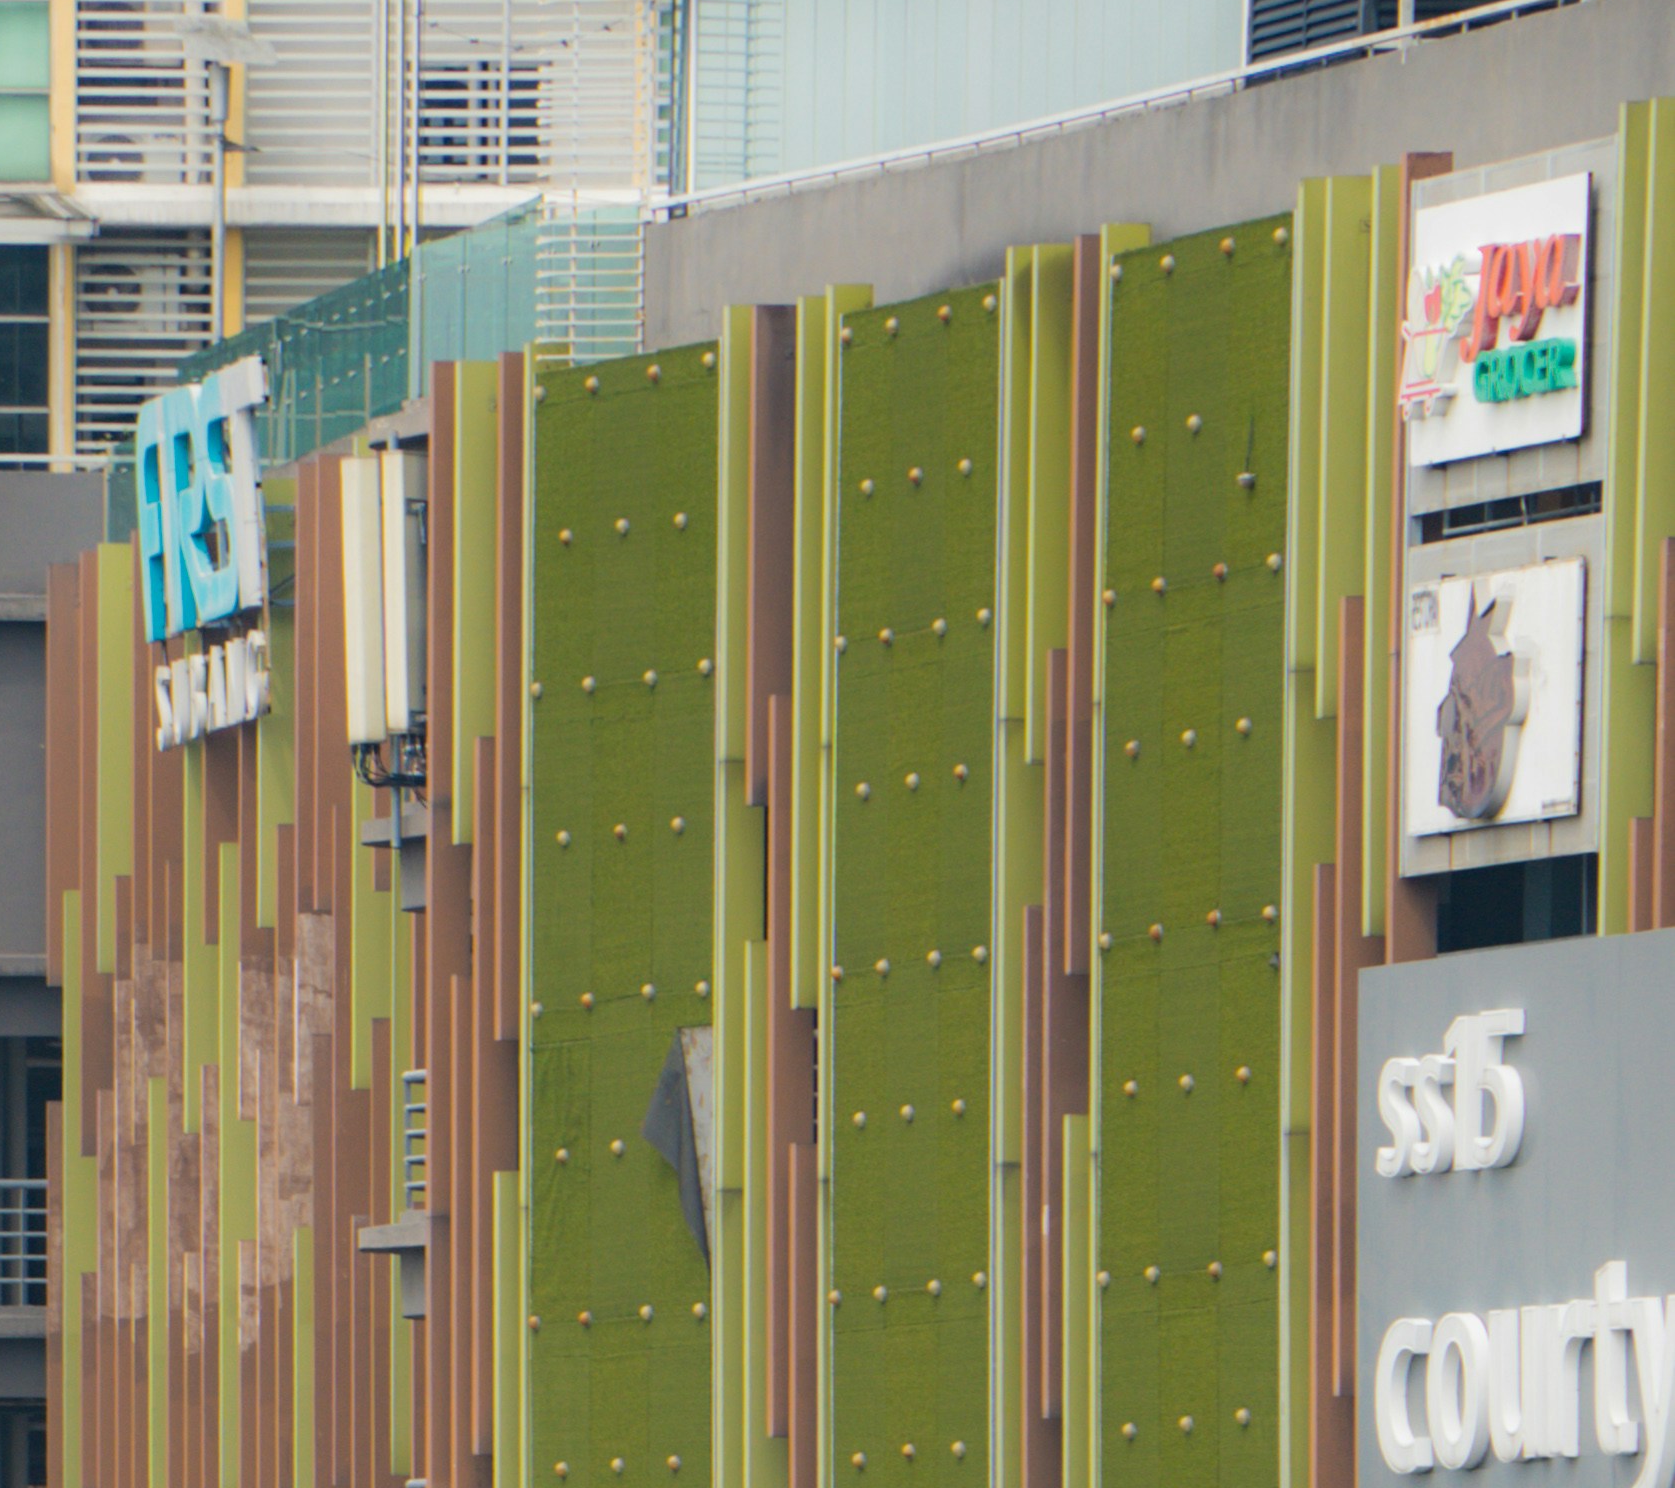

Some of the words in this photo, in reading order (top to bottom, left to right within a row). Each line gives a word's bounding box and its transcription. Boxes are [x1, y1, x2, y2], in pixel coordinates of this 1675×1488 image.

[1459, 233, 1582, 364] Jaya
[1474, 336, 1578, 403] GROCER
[136, 355, 268, 643] FIRST
[155, 629, 271, 752] SUBANG
